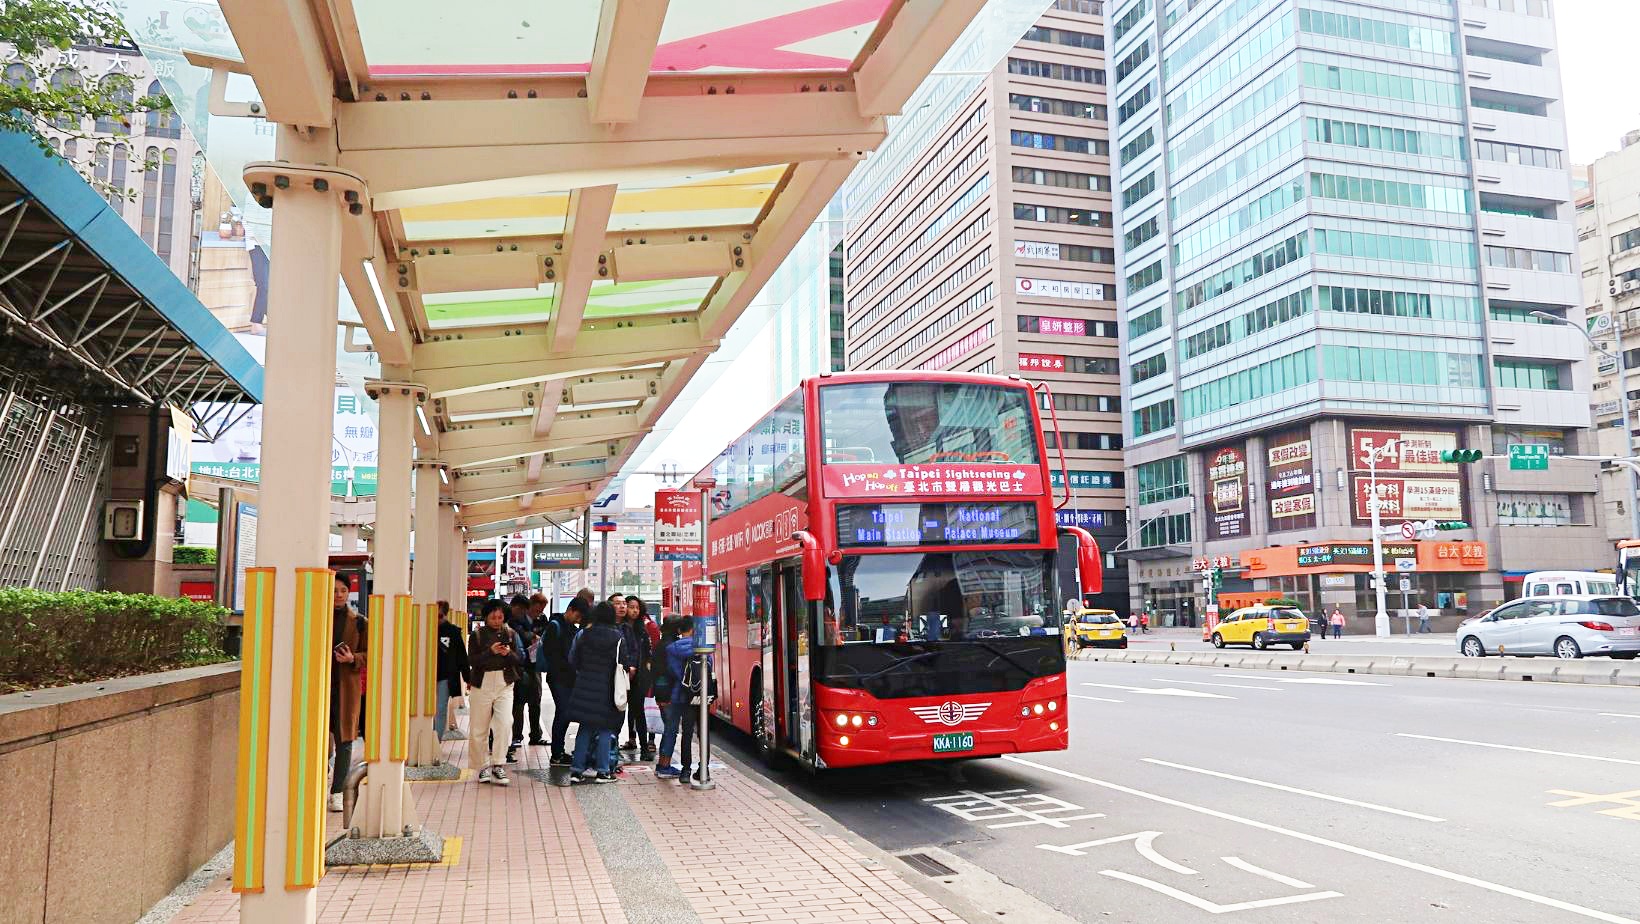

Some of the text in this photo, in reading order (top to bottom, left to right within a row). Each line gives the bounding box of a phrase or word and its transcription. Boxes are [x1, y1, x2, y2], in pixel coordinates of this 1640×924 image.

[1040, 284, 1102, 296] 大和房屋工業
[1041, 319, 1085, 333] 皇妍整形
[1272, 444, 1308, 462] 寒假改變
[1405, 449, 1445, 464] 最佳選
[842, 472, 880, 487] Hop on
[899, 467, 1011, 480] Taipei Sightseeing
[864, 480, 899, 493] Hop off
[903, 481, 1024, 493] 臺北市雙層觀光巴士
[1274, 496, 1312, 513] 改變寒假
[871, 511, 905, 525] Taipei
[958, 507, 1001, 522] National
[857, 528, 922, 541] Main Station
[943, 526, 1019, 539] Palace Museum
[933, 735, 974, 750] KKA-1160
